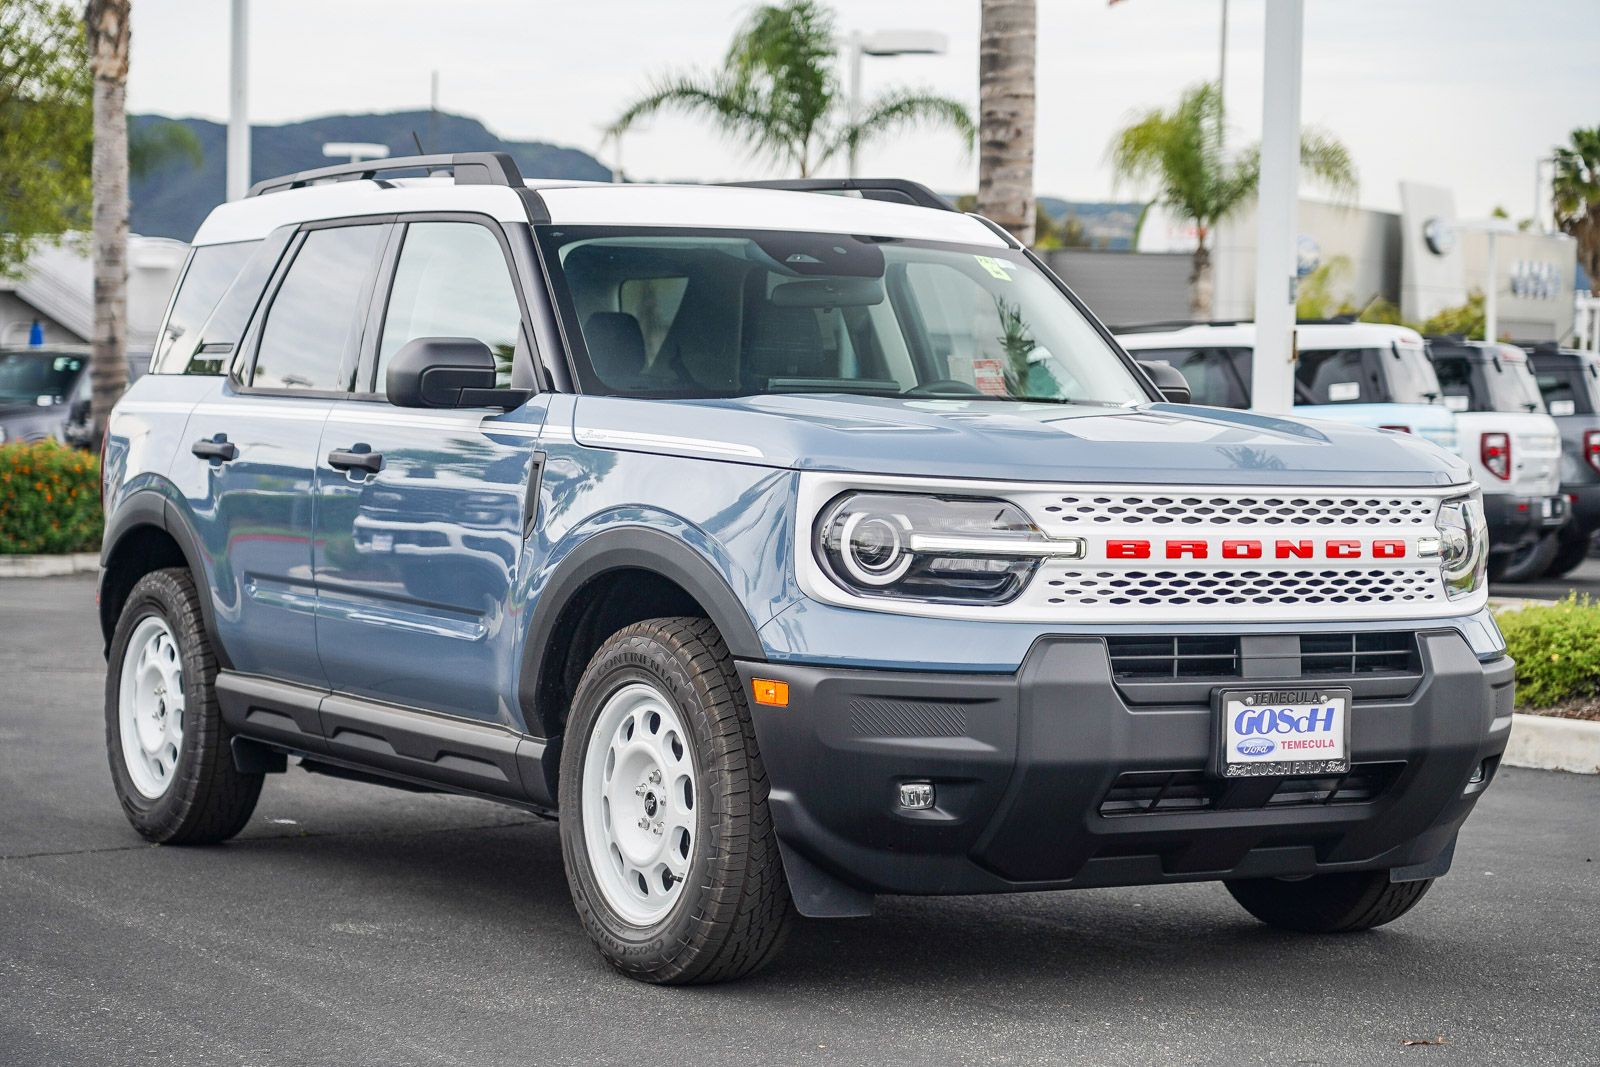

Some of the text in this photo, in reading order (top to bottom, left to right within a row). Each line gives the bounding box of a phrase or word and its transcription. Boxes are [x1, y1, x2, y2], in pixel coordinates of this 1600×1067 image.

[1106, 539, 1406, 559] BRONCO
[597, 652, 679, 693] CONTINENTAL
[1253, 691, 1319, 704] TEMECULA
[1281, 739, 1335, 750] TEMECULA
